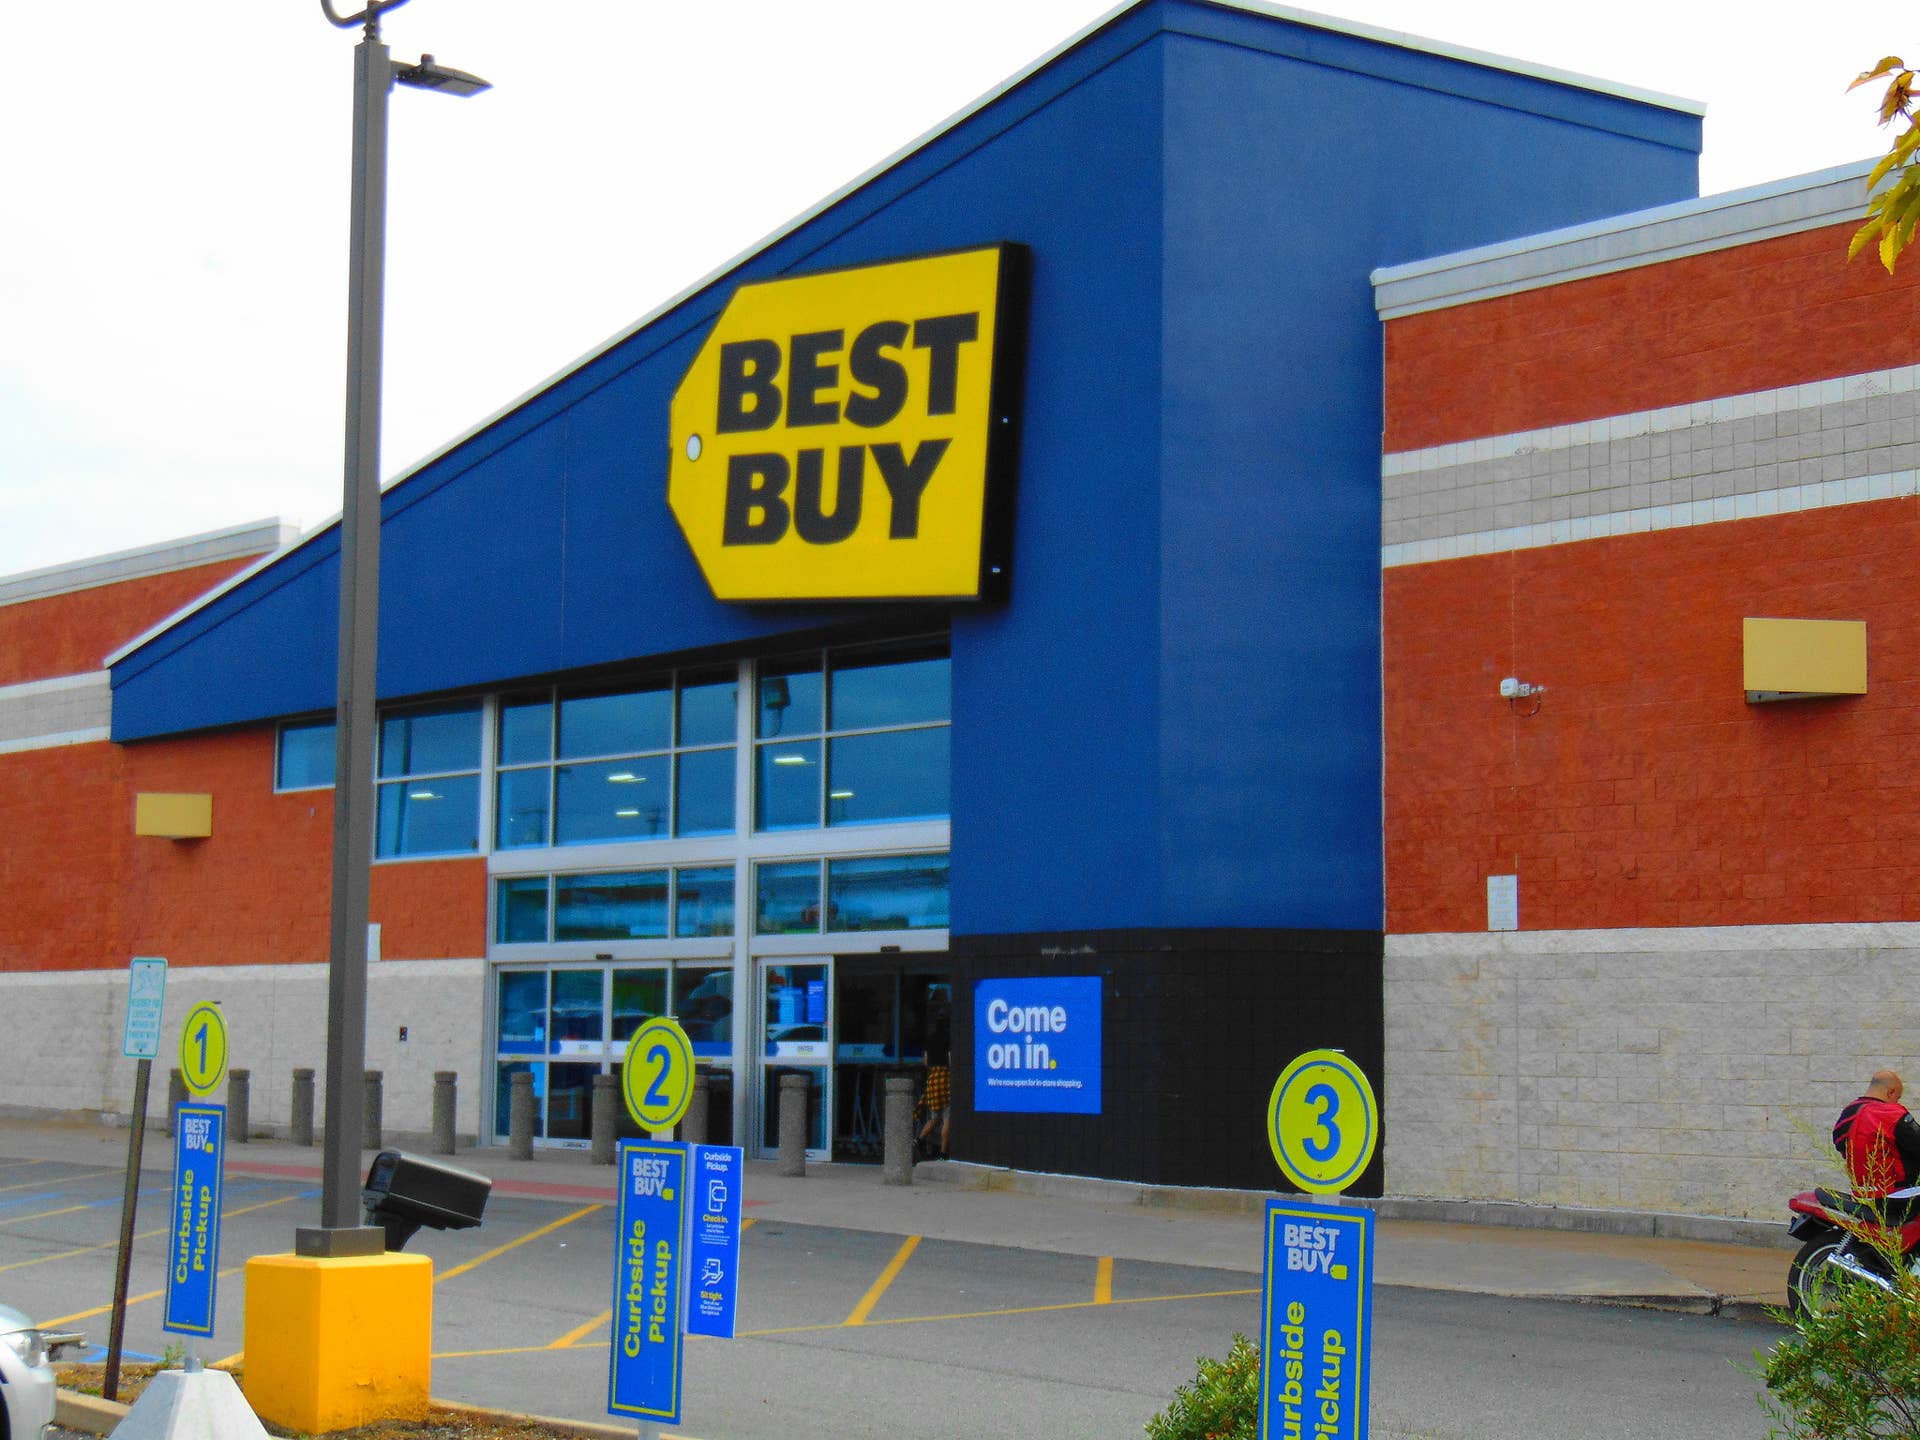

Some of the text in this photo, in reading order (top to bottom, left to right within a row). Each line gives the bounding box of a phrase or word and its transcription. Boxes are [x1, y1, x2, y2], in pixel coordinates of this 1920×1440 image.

[717, 312, 980, 435] BEST
[722, 438, 953, 547] BUY
[988, 999, 1067, 1033] Come
[195, 1022, 208, 1074] 1
[644, 1044, 672, 1106] 2
[988, 1035, 1057, 1070] on in.
[185, 1117, 211, 1135] BEST
[186, 1135, 208, 1150] BUY
[1302, 1083, 1341, 1162] 3
[633, 1158, 669, 1178] BEST
[635, 1176, 665, 1197] BUY
[176, 1169, 194, 1284] Curbside
[195, 1186, 212, 1271] Pickup
[1285, 1223, 1340, 1251] BEST
[624, 1219, 646, 1358] Curbside
[1287, 1247, 1333, 1274] BUY
[649, 1239, 673, 1343] Pickup
[1279, 1301, 1305, 1440] urbside
